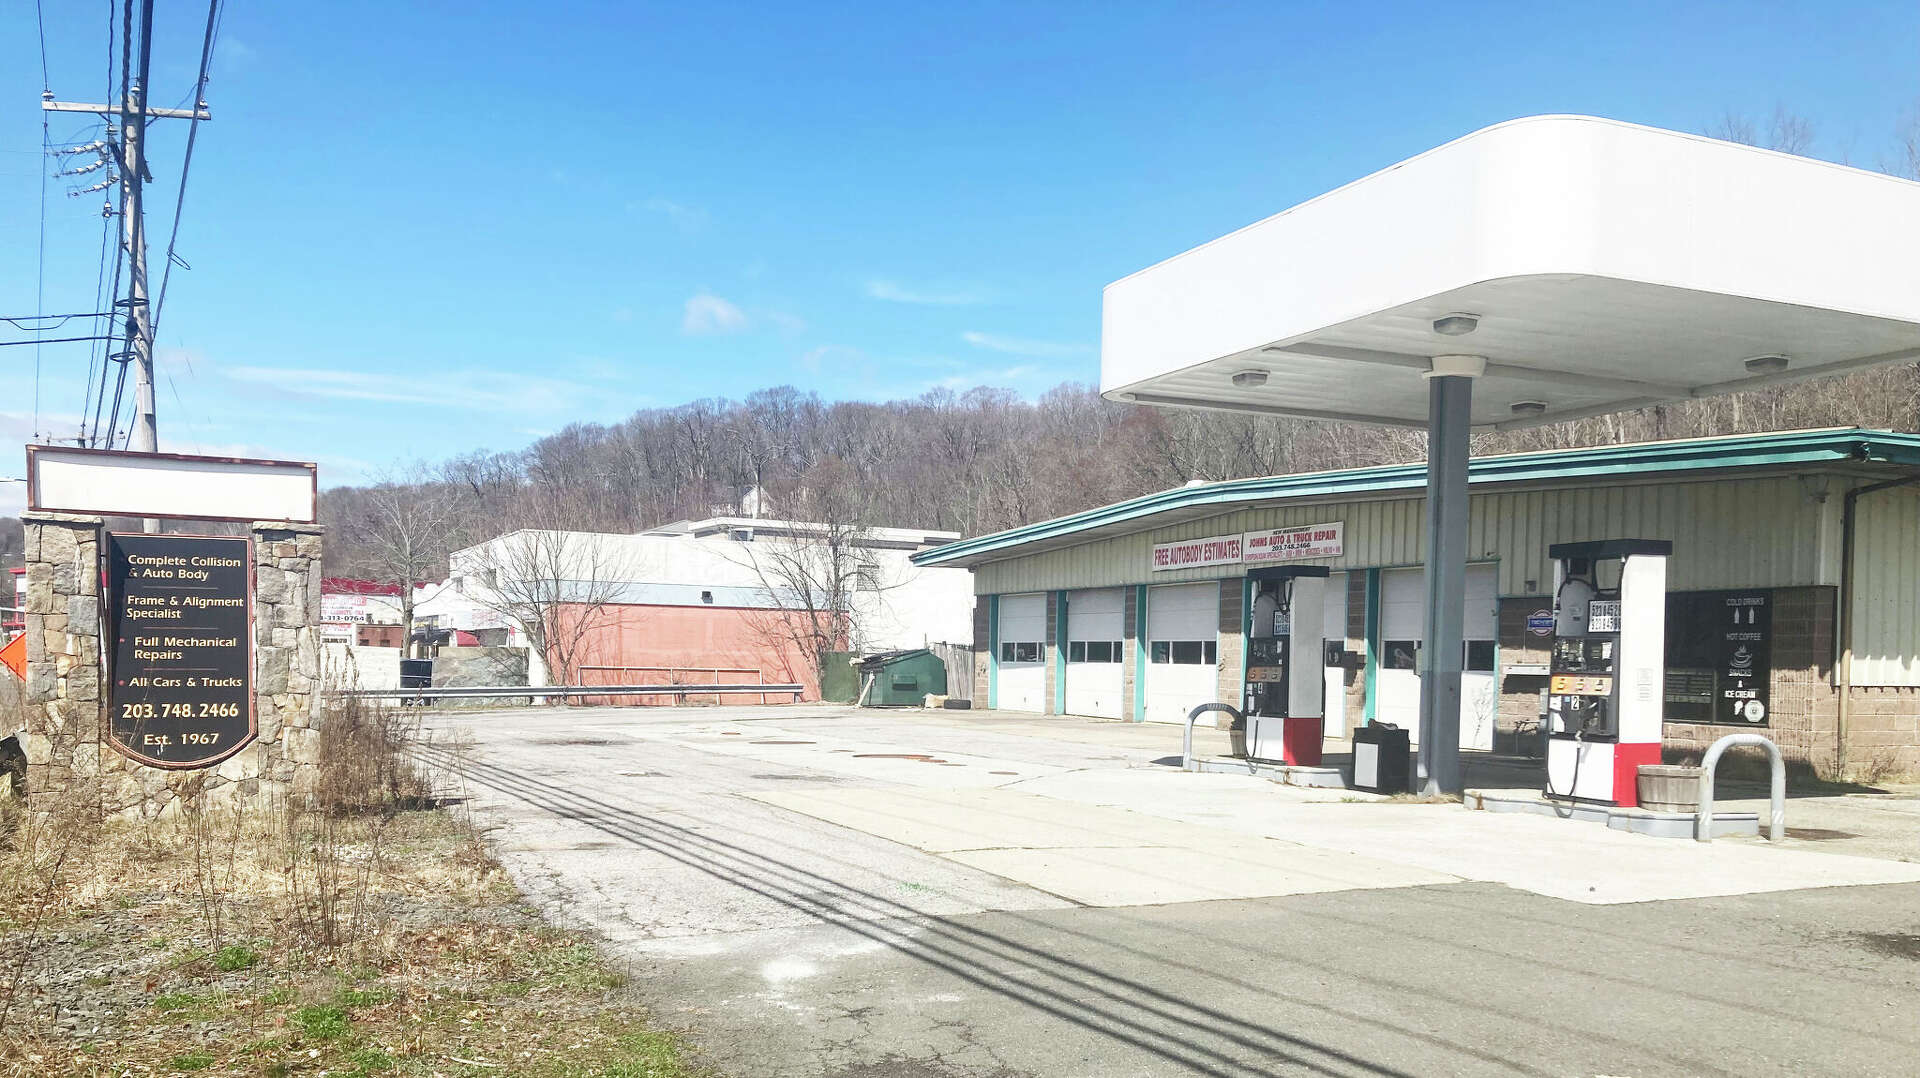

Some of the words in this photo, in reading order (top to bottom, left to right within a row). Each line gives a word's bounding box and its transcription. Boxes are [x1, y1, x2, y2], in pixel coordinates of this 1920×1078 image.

[1249, 536, 1268, 548] JOHNS
[1269, 534, 1285, 546] AUTO
[1286, 534, 1291, 544] &
[1293, 532, 1313, 543] TRUCK
[1314, 530, 1337, 541] REPAIR
[1154, 548, 1169, 566] FREE
[1170, 543, 1204, 565] AUTOBODY
[1204, 539, 1240, 561] ESTIMATES
[127, 554, 187, 567] Complete
[190, 556, 241, 567] Collision
[128, 567, 138, 578] &
[142, 568, 174, 578] Auto
[178, 569, 209, 581] Body
[127, 595, 165, 606] Frame
[169, 596, 178, 606] &
[182, 597, 244, 608] Alignment
[126, 607, 181, 620] Specialist
[134, 636, 158, 647] Full
[164, 637, 237, 647] Mechanical
[134, 649, 182, 661] Repairs
[129, 677, 147, 687] All
[153, 678, 181, 687] Cars
[186, 678, 196, 687] &
[201, 678, 242, 687] Trucks
[1725, 690, 1735, 698] ICE
[1735, 690, 1756, 698] CREAM
[1572, 696, 1578, 710] 2
[143, 734, 172, 746] Est.
[181, 732, 220, 745] 1967
